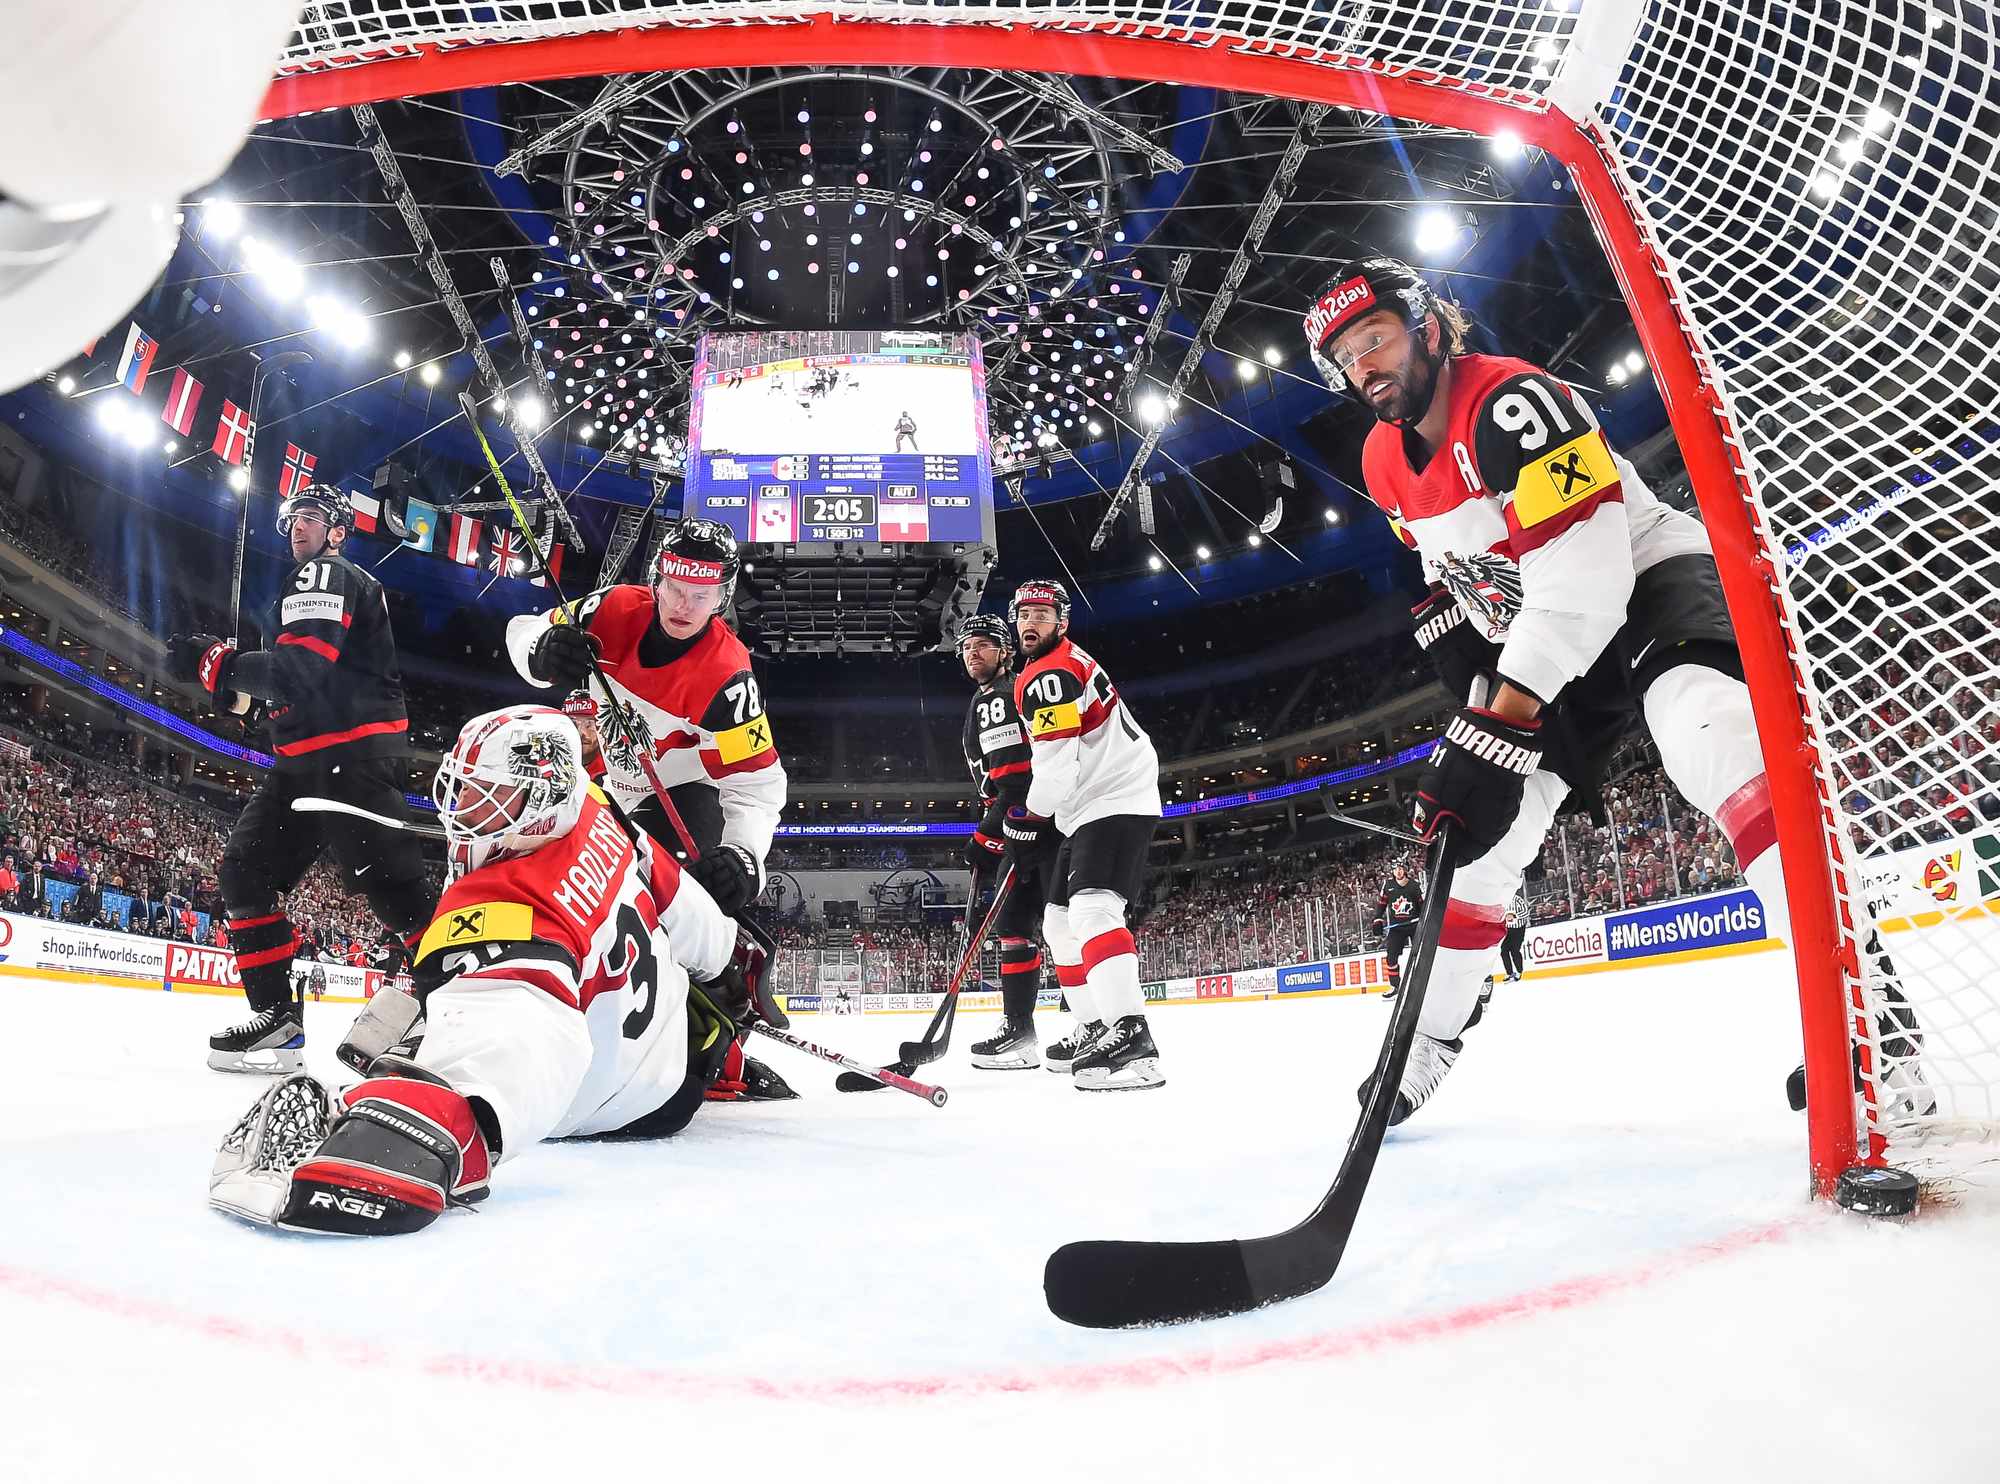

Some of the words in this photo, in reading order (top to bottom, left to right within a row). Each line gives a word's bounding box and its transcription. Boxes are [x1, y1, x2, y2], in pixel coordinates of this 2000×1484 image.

[1493, 379, 1572, 451] 91
[1453, 441, 1482, 494] A
[765, 487, 785, 497] CAN
[893, 487, 913, 497] AUT
[813, 499, 863, 521] 2:05
[812, 528, 824, 538] 33
[853, 528, 864, 538] 12
[295, 561, 332, 591] 91
[725, 678, 763, 724] 78
[1026, 673, 1063, 704] 70
[976, 697, 1006, 729] 38
[803, 826, 835, 834] HOCKEY
[837, 826, 867, 834] WORLD
[868, 826, 928, 834] CHAMPIONSHIP
[1610, 901, 1761, 951] #MensWorlds
[42, 936, 163, 968] shop.iihfworlds.com
[340, 973, 363, 986] TISSOT
